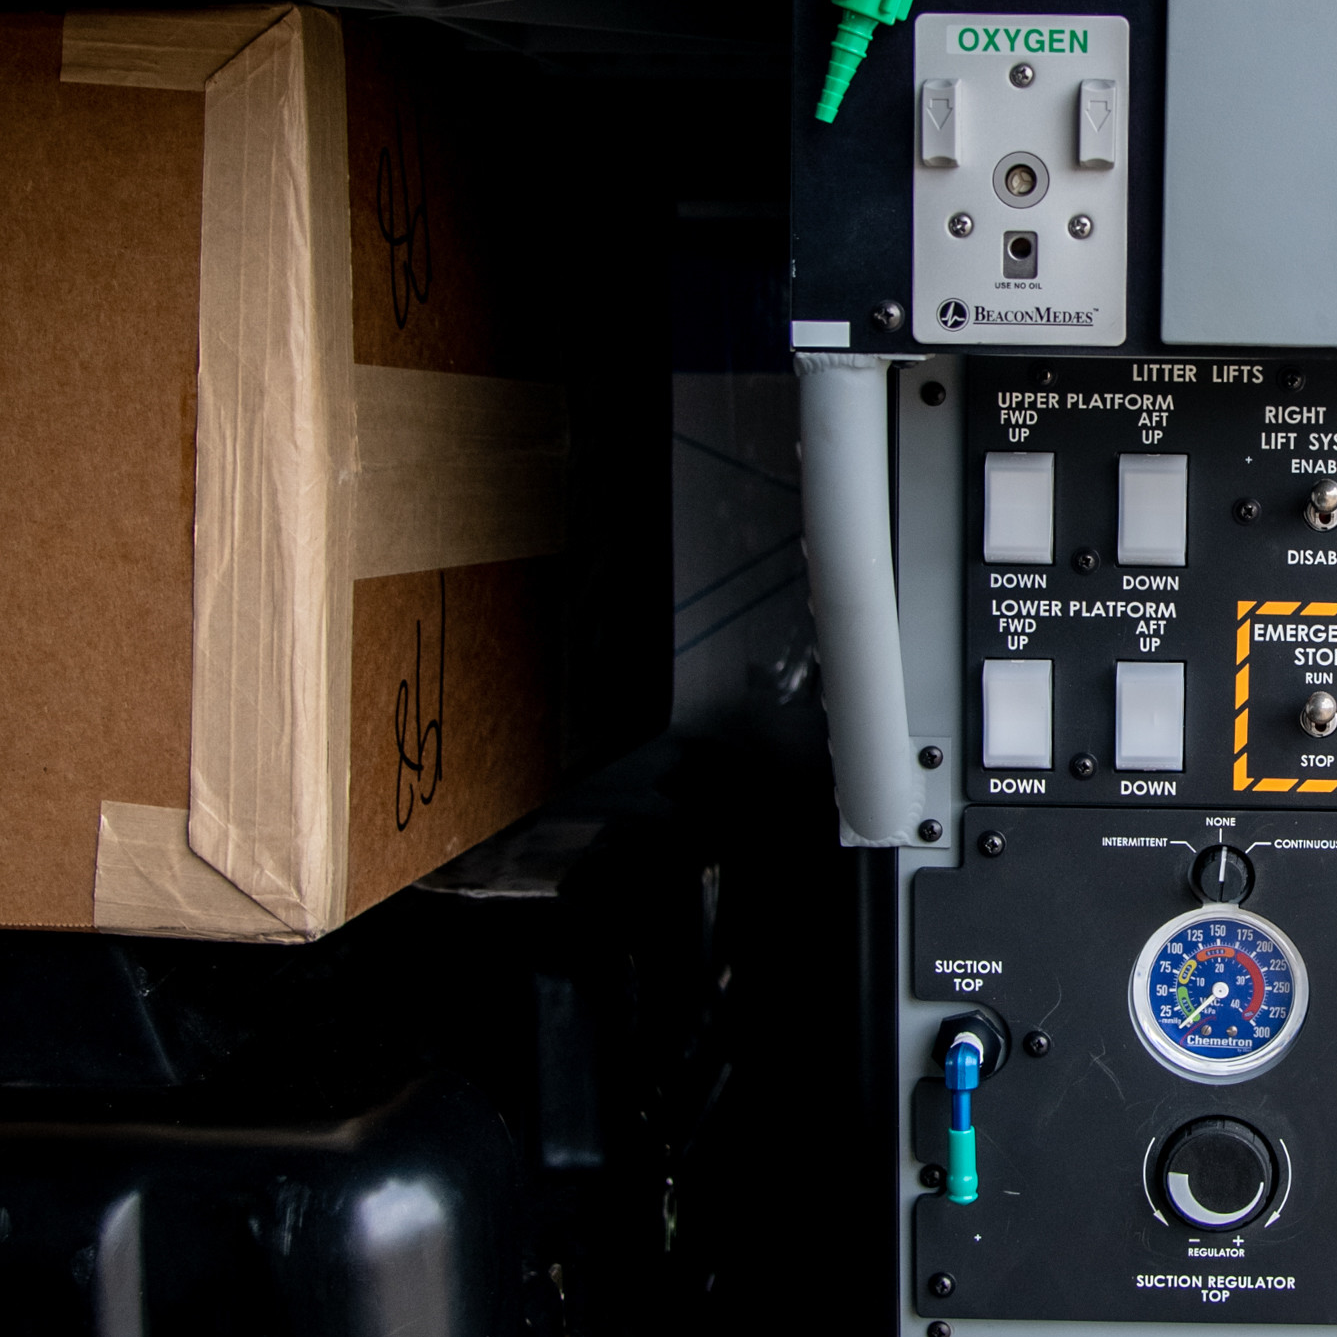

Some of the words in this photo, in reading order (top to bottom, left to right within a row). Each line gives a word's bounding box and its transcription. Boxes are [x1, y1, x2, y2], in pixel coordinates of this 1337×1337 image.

[958, 28, 1089, 54] OXYGEN
[994, 282, 1013, 290] USE
[1014, 282, 1027, 290] NO
[1028, 282, 1042, 290] OIL
[1132, 363, 1197, 383] LITTER
[1212, 365, 1264, 384] LIFTS
[998, 392, 1059, 409] UPPER
[1067, 393, 1175, 411] PLATFORM
[1000, 409, 1038, 425] FWD
[1138, 412, 1169, 427] AFT
[1265, 405, 1327, 425] RIGHT
[1009, 427, 1030, 443] UP
[1142, 429, 1163, 445] UP
[1261, 432, 1298, 450] LIFT
[990, 573, 1047, 589] DOWN
[1122, 575, 1179, 591] DOWN
[992, 599, 1062, 617] LOWER
[1069, 600, 1177, 619] PLATFORM
[999, 618, 1037, 633] FWD
[1135, 620, 1167, 635] AFT
[1007, 635, 1029, 650] UP
[1139, 637, 1161, 652] UP
[1305, 672, 1333, 685] RUN
[1300, 754, 1335, 768] STOP
[990, 778, 1046, 794] DOWN
[1120, 780, 1177, 796] DOWN
[1205, 817, 1236, 827] NONE
[1102, 836, 1168, 847] INTERMITTENT
[1187, 930, 1203, 941] 125
[1210, 925, 1226, 936] 150
[1238, 929, 1254, 941] 175
[1167, 943, 1183, 954] 100
[1256, 941, 1273, 952] 200
[935, 959, 1003, 974] SUCTION
[1160, 961, 1171, 972] 75
[1215, 964, 1224, 973] 20
[1270, 960, 1287, 971] 225
[953, 978, 984, 992] TOP
[1197, 978, 1205, 987] 10
[1236, 976, 1246, 985] 30
[1273, 982, 1290, 993] 250
[1156, 985, 1167, 996] 50
[1231, 999, 1240, 1008] 40
[1160, 1006, 1172, 1017] 25
[1269, 1007, 1286, 1018] 275
[1254, 1027, 1270, 1038] 300
[1187, 1035, 1252, 1047] Chemetron
[1188, 1247, 1245, 1258] REGULATOR
[1136, 1274, 1203, 1288] SUCTION
[1207, 1275, 1296, 1289] REGULATOR
[1201, 1289, 1230, 1303] TOP
